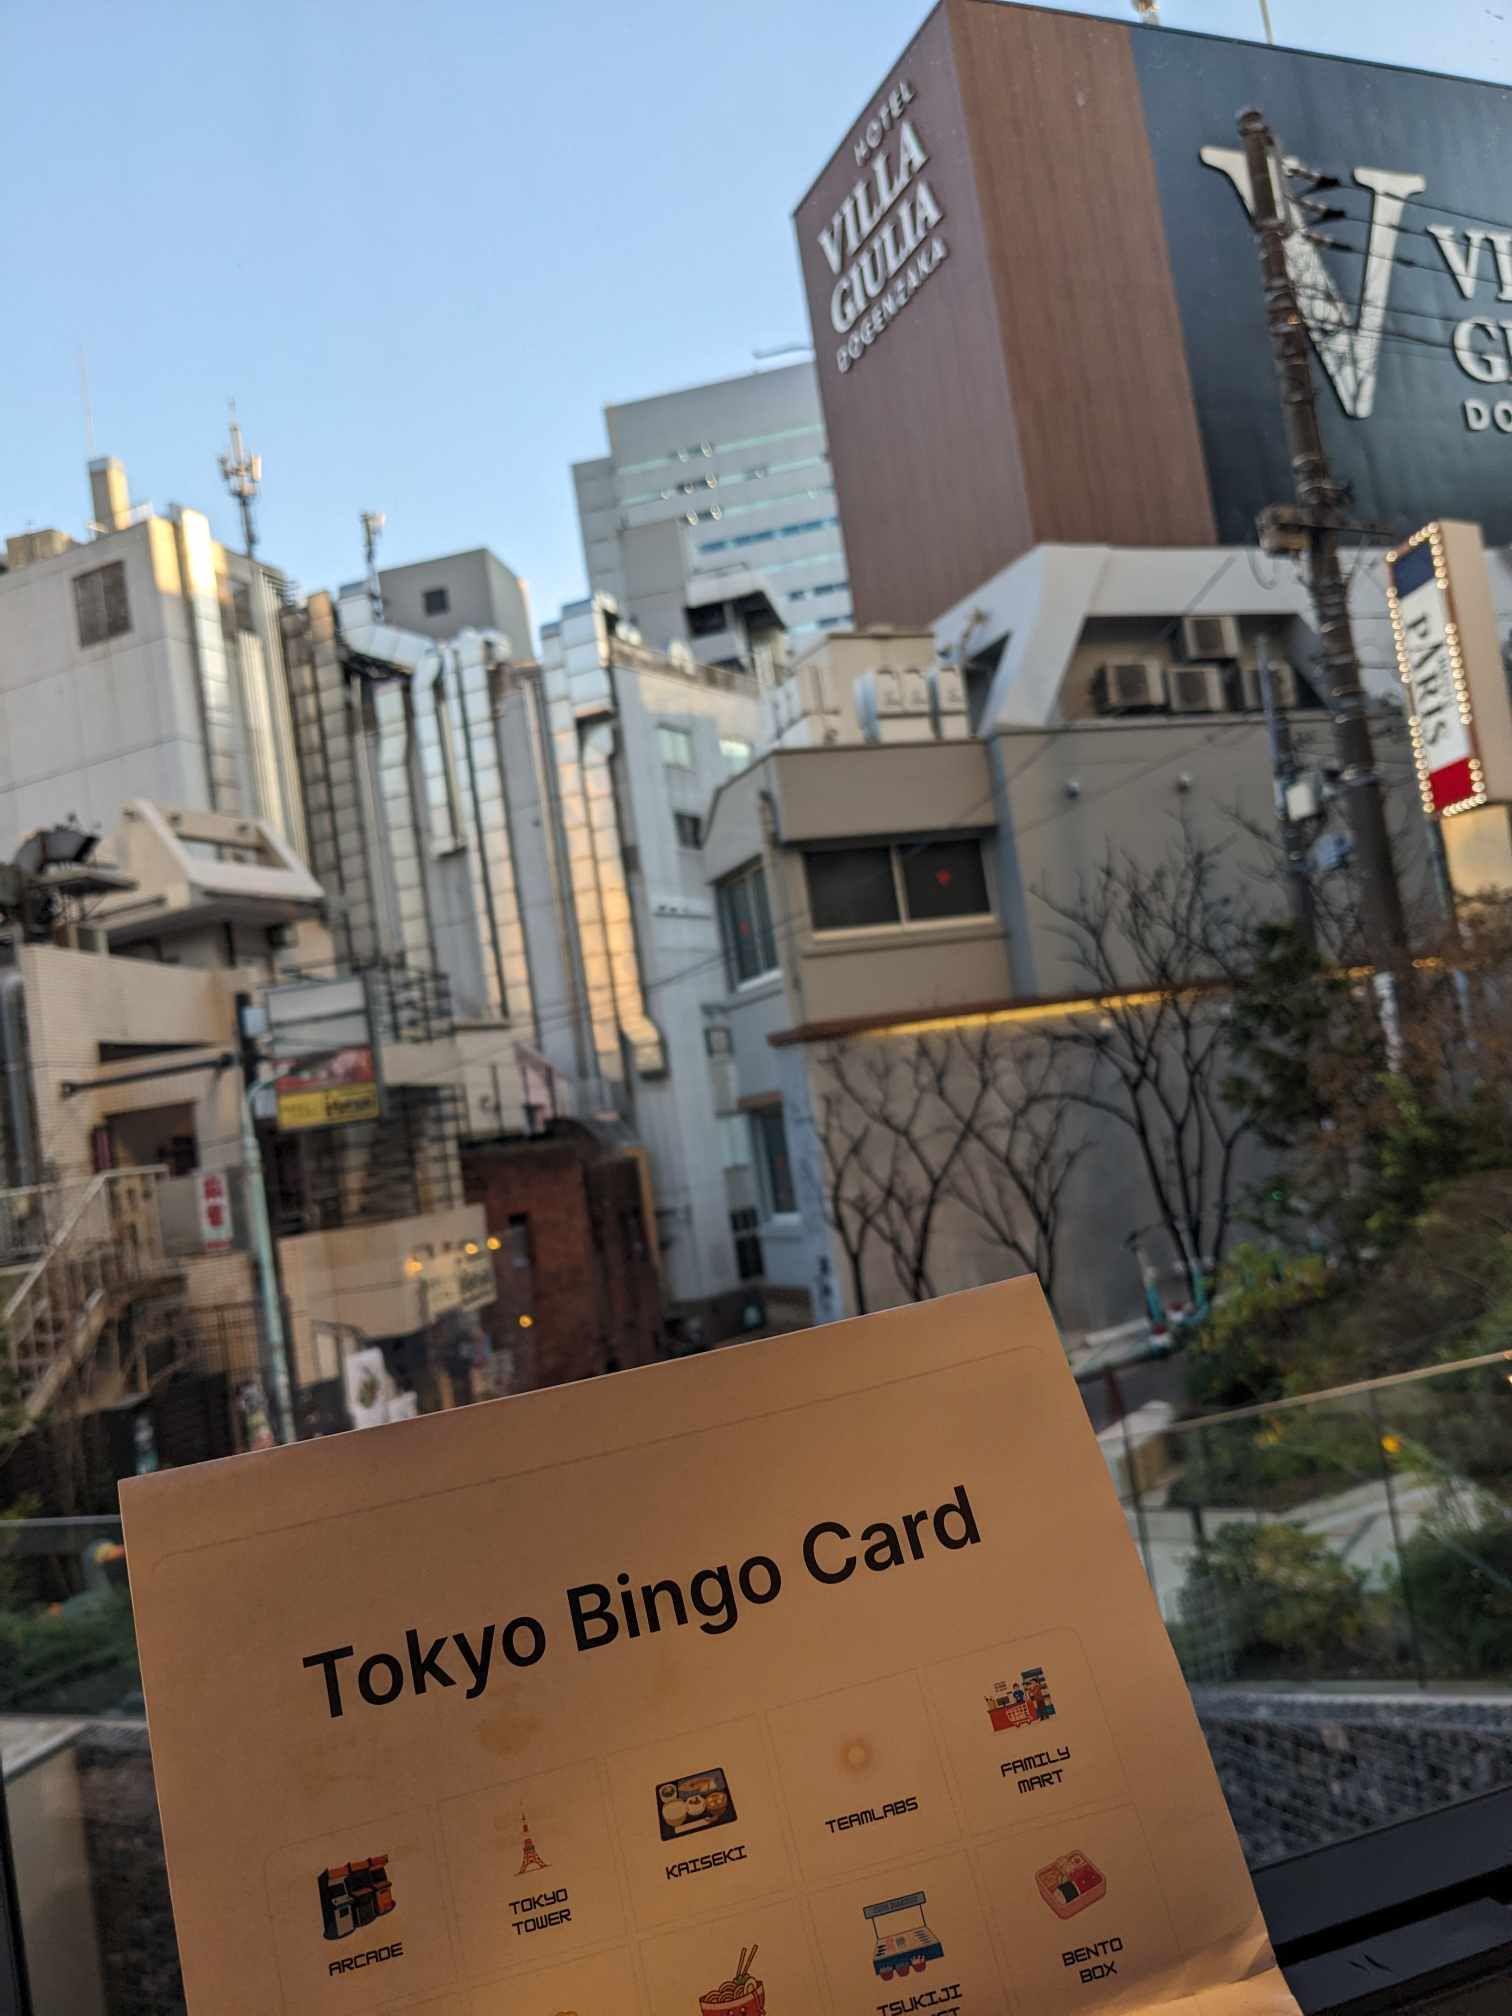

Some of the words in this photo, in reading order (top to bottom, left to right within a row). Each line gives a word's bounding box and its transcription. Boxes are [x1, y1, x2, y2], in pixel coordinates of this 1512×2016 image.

[854, 80, 916, 167] HOTEL
[818, 120, 930, 275] VILLA
[830, 179, 943, 334] GIULIA
[1200, 146, 1427, 418] V
[836, 237, 948, 374] DOGENZAKA
[1406, 613, 1447, 746] PARIS
[302, 1617, 546, 1719] Tokyo
[566, 1556, 781, 1652] Bingo
[803, 1485, 982, 1585] Card
[1000, 1746, 1071, 1778] FAMILY
[1017, 1768, 1064, 1795] MART
[825, 1797, 919, 1834] TEAMLABS
[665, 1845, 748, 1880] KAISEKI
[508, 1888, 569, 1915] TOKYO
[511, 1908, 572, 1936] TOWER
[328, 1942, 404, 1977] ARCADE
[1062, 1937, 1124, 1967] BENTO
[1080, 1960, 1118, 1984] BOX
[877, 1983, 963, 2016] TSUKIJI
